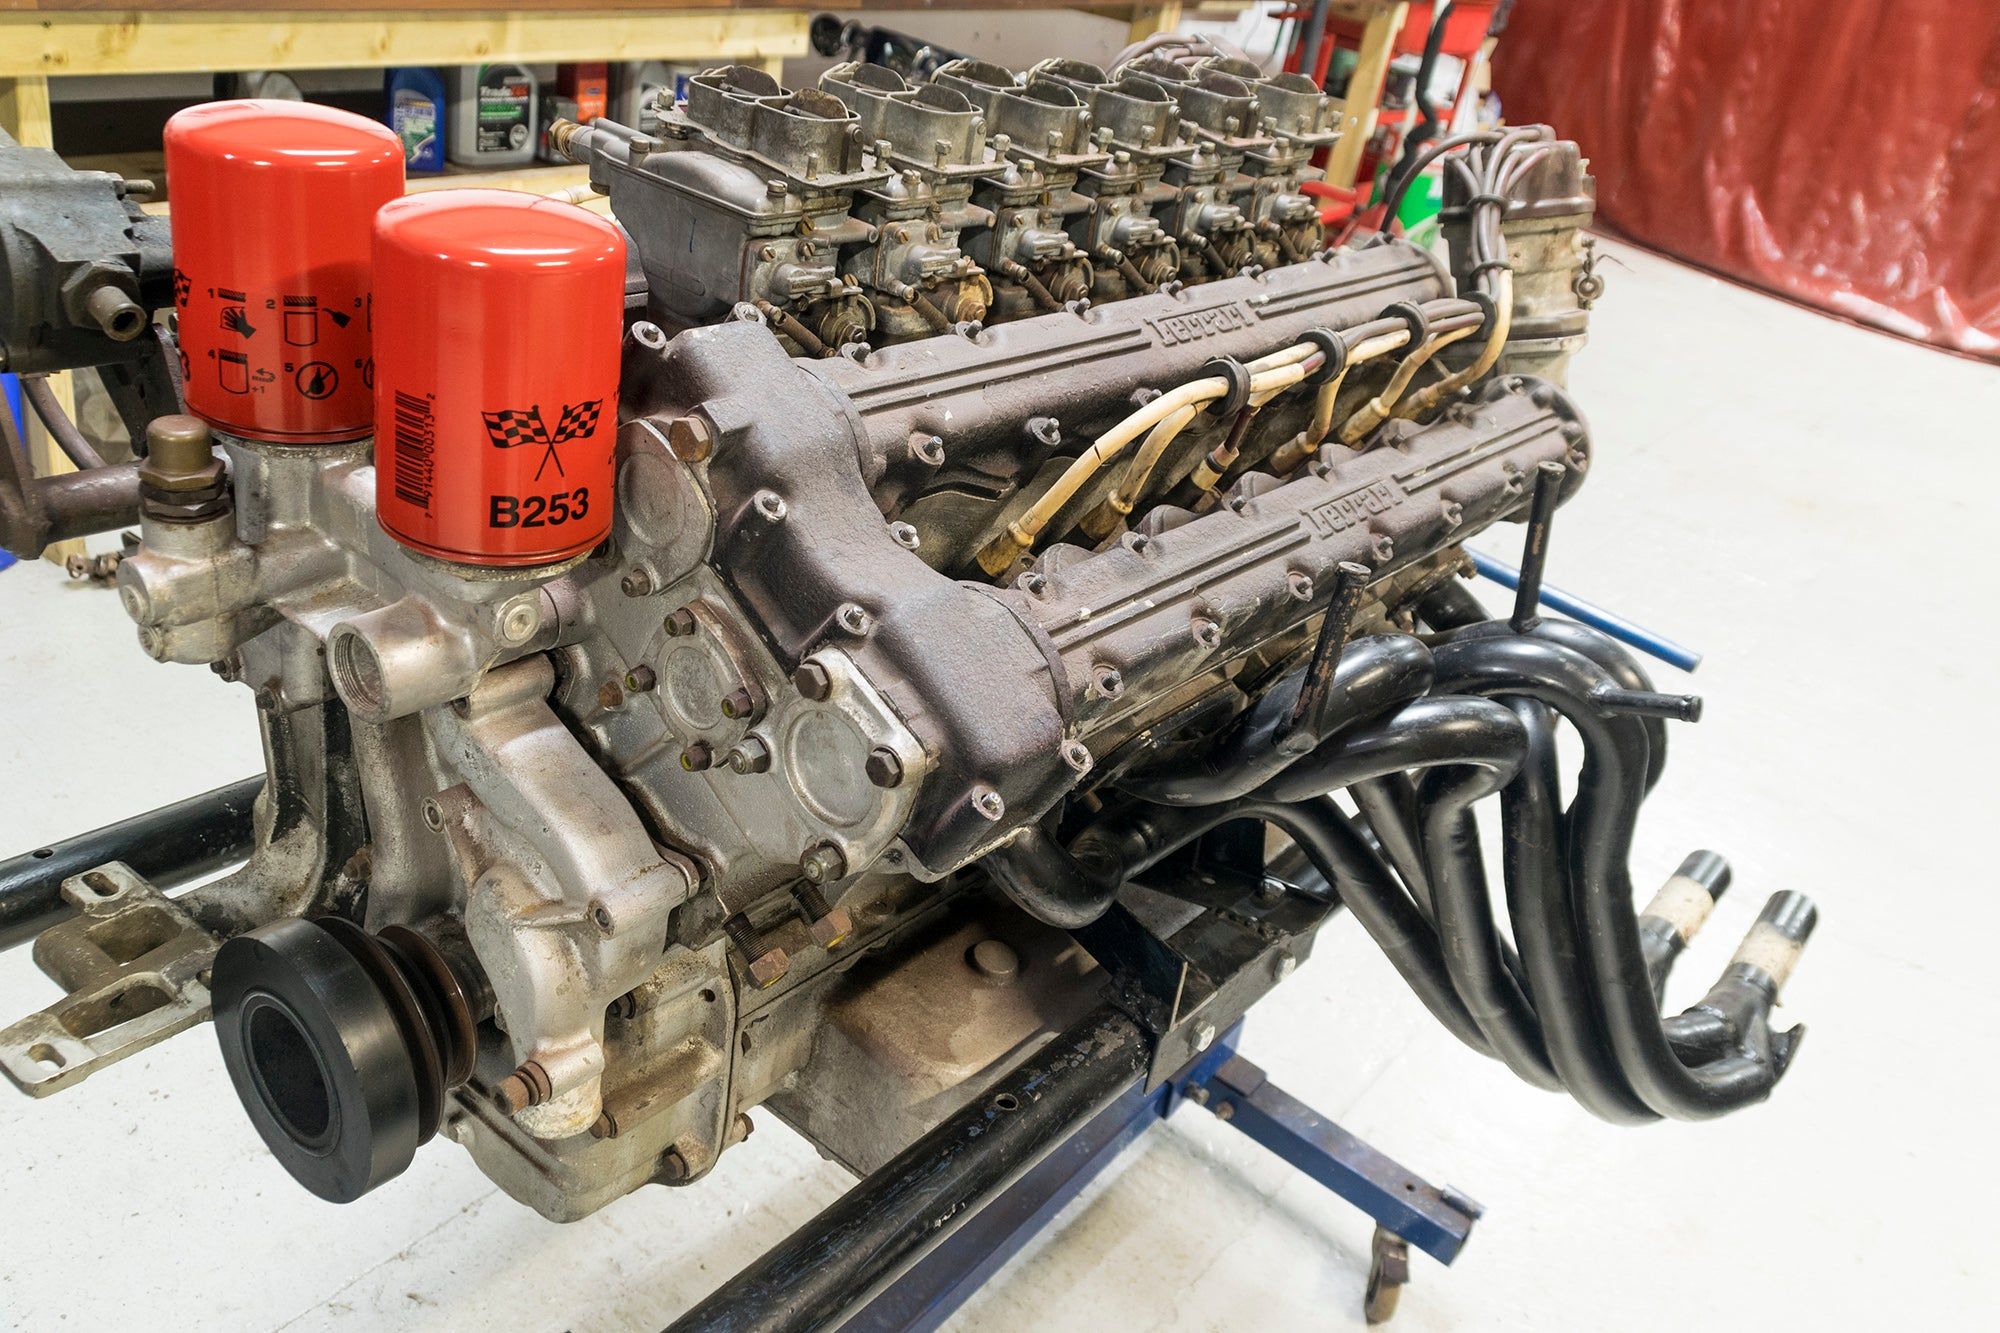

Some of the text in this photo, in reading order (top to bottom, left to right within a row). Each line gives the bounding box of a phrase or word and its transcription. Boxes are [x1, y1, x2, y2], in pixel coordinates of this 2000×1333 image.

[207, 287, 214, 298] 1
[266, 299, 275, 309] 2
[354, 297, 362, 308] 3
[1144, 298, 1255, 347] Ferrari
[208, 349, 215, 359] 4
[284, 362, 294, 373] 5
[354, 359, 362, 369] 6
[426, 393, 436, 401] 2
[424, 414, 435, 454] 00313
[424, 459, 434, 498] 91440
[489, 486, 589, 529] B253
